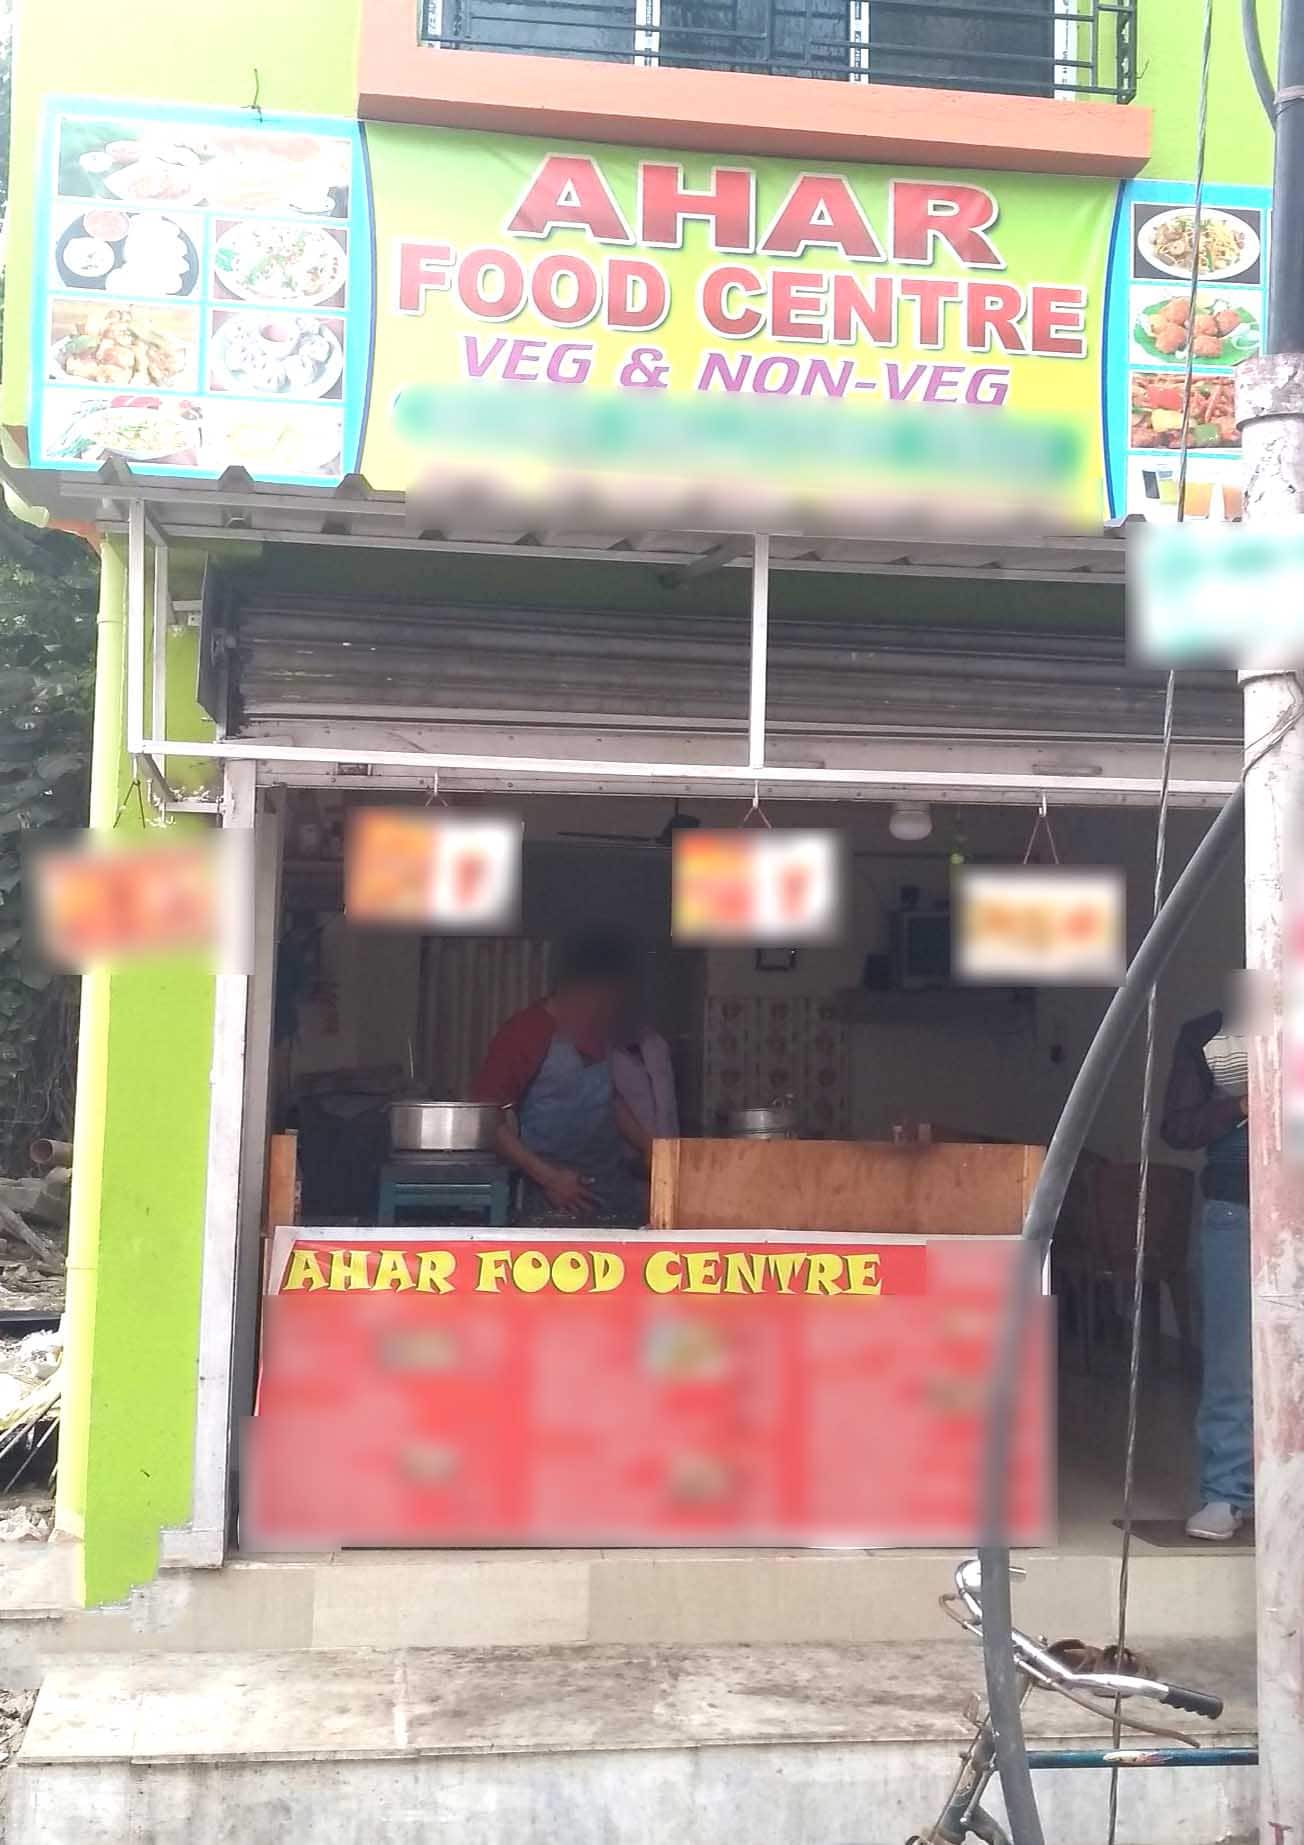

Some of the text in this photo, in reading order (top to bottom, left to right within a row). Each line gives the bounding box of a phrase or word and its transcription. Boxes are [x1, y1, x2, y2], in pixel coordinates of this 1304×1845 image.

[509, 156, 1003, 267] AHAR
[399, 244, 1087, 356] FOOD CENTRE
[464, 337, 1010, 406] VEG & NON-VEG
[284, 1250, 882, 1296] AHAR FOOD CENTRE
